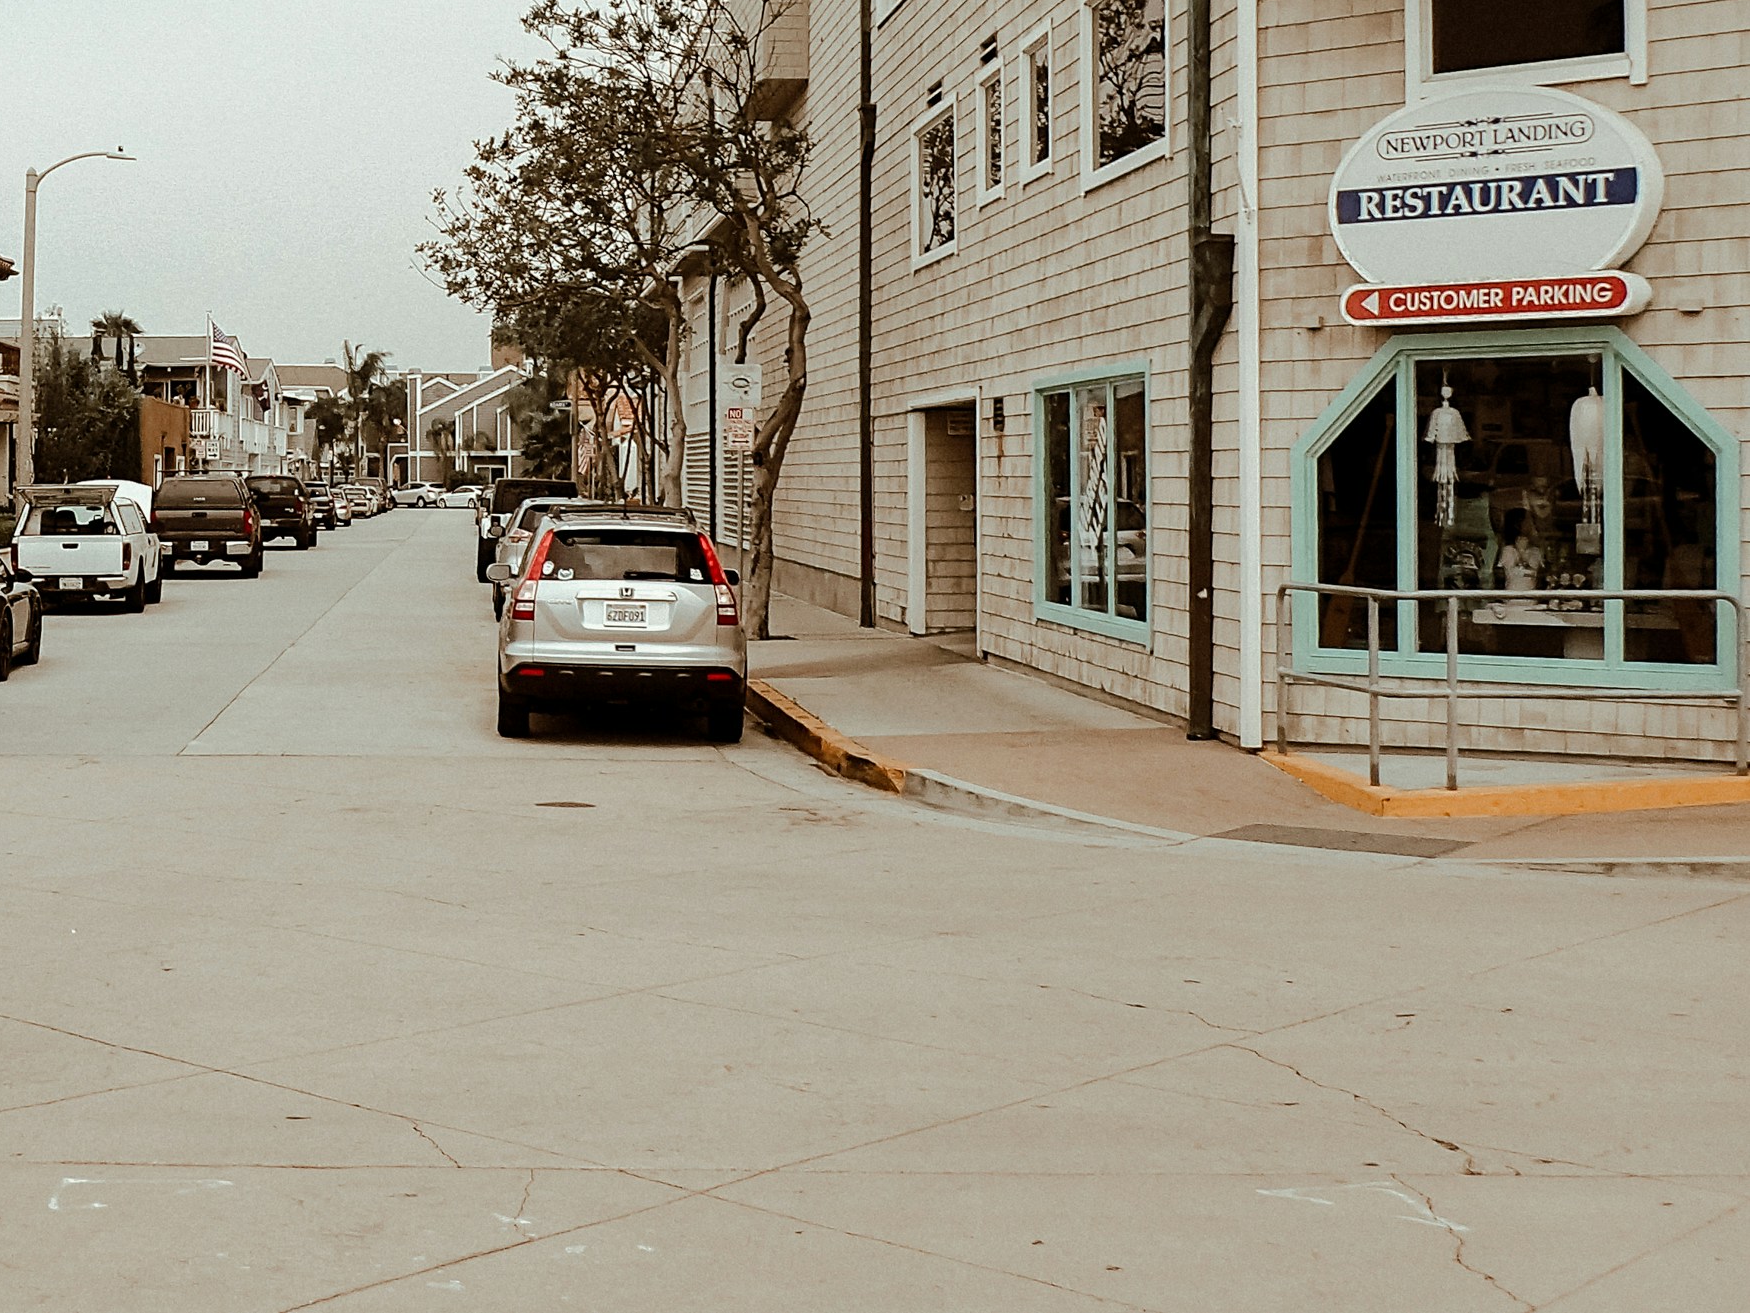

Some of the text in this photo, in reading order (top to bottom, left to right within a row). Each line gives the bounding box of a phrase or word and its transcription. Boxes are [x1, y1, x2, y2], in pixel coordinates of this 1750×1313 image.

[1386, 120, 1586, 155] NEWPORT LANDING
[1377, 157, 1596, 183] WATERFRONT DINING FRESH SEAFOOD
[1357, 172, 1614, 221] RESTAURANT
[1388, 282, 1613, 312] CUSTOMER PARKING
[729, 409, 741, 418] NO
[607, 610, 645, 622] 6ZDF091
